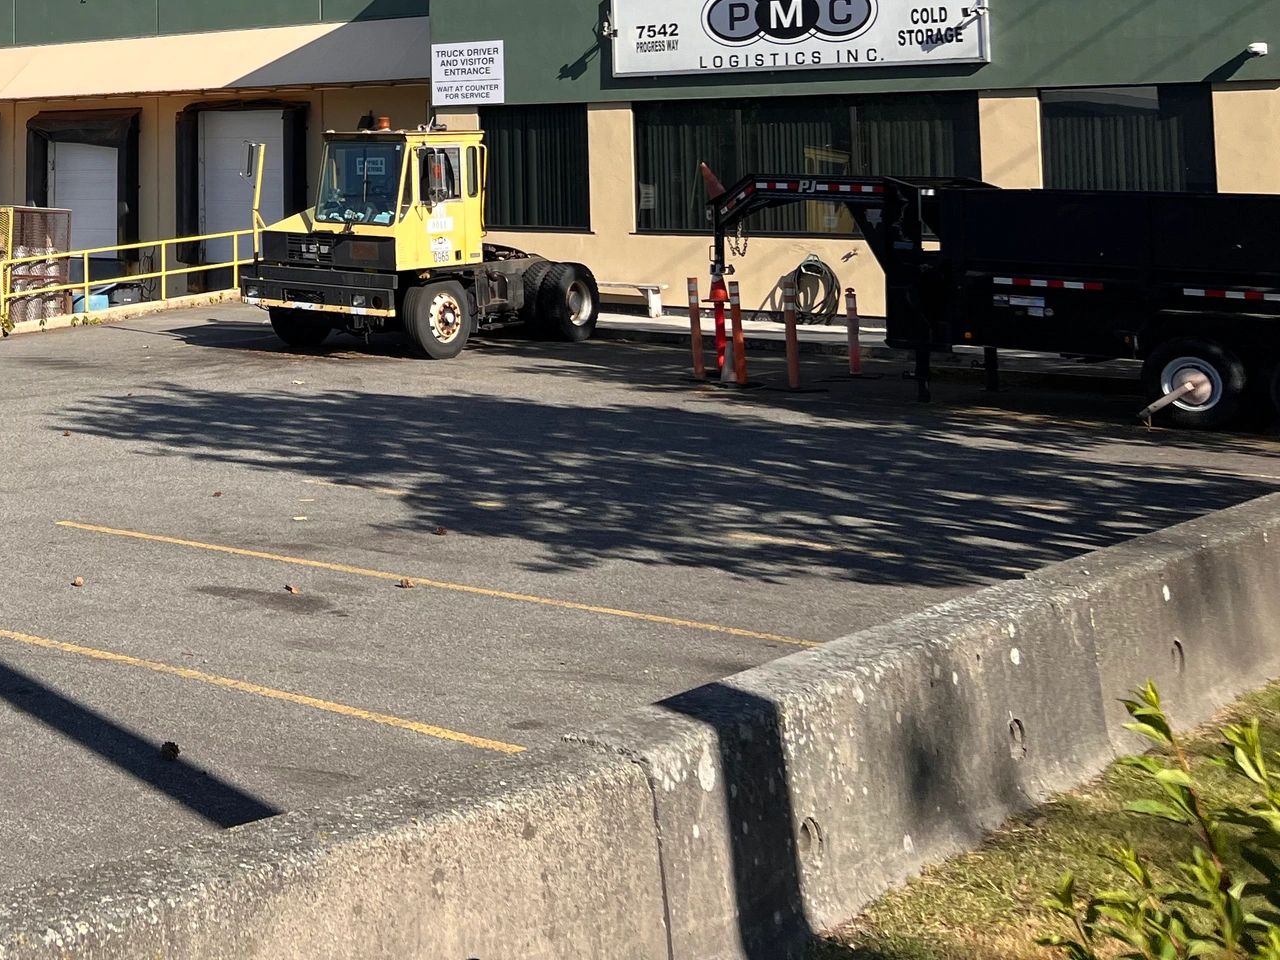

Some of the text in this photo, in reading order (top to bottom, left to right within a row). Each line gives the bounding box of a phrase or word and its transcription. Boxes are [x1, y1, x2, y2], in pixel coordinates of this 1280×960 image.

[910, 7, 948, 24] COLD
[636, 23, 679, 39] 7542
[898, 26, 964, 46] STORAGE
[436, 47, 499, 58] TRUCK DRIVER
[636, 39, 679, 53] PROGRESS WAY
[440, 57, 495, 67] AND VISITOR
[699, 48, 884, 69] LOGISTICS INC.
[444, 67, 491, 76] ENTRANCE
[465, 84, 499, 92] COUNTER
[798, 180, 817, 193] PJ
